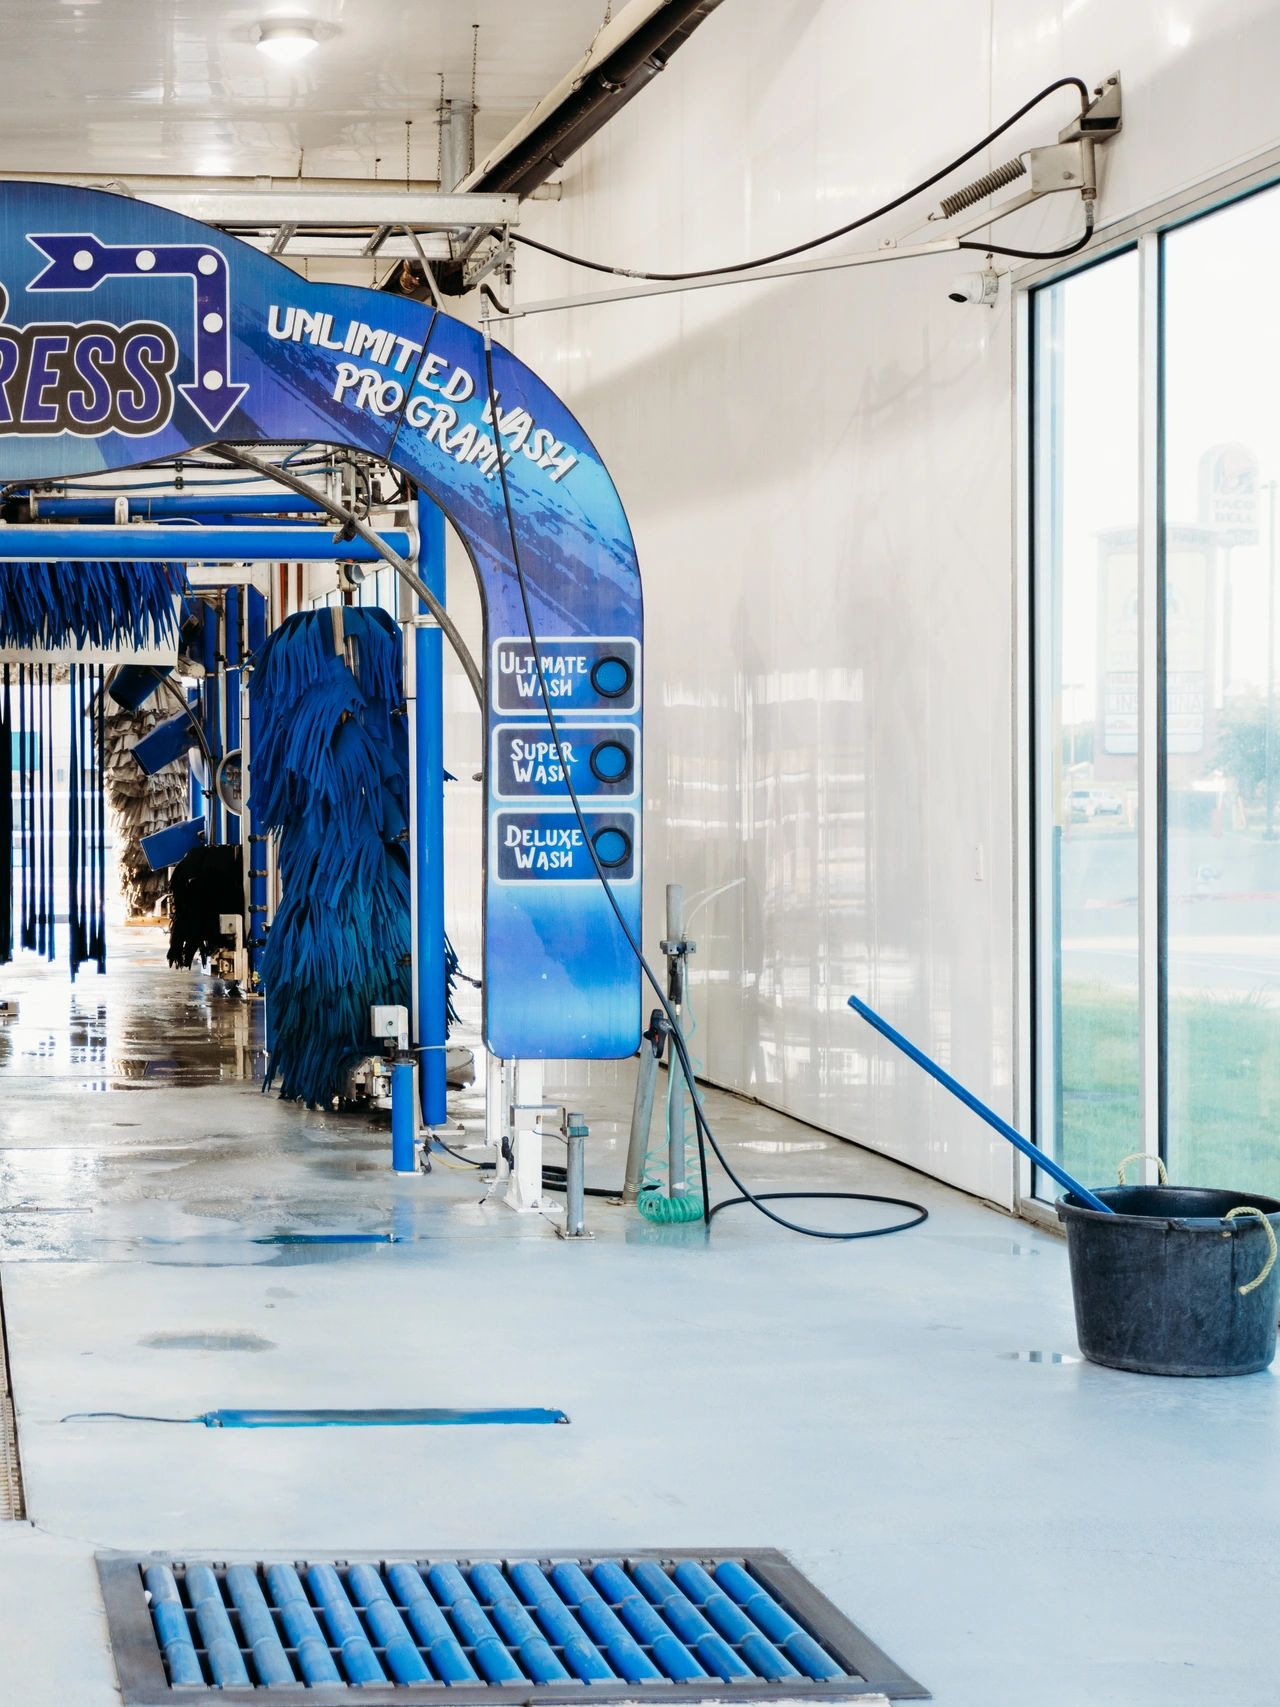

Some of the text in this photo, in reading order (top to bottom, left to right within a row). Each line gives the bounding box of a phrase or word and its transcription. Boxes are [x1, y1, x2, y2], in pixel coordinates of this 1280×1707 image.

[267, 305, 579, 482] UNLIMITED WASH
[332, 362, 512, 480] PROGRAM!
[500, 651, 588, 676] ULTMATE
[510, 738, 579, 763] SUPER
[512, 760, 571, 784] WASH
[504, 825, 584, 850] DELUXE
[514, 847, 573, 871] WASH
